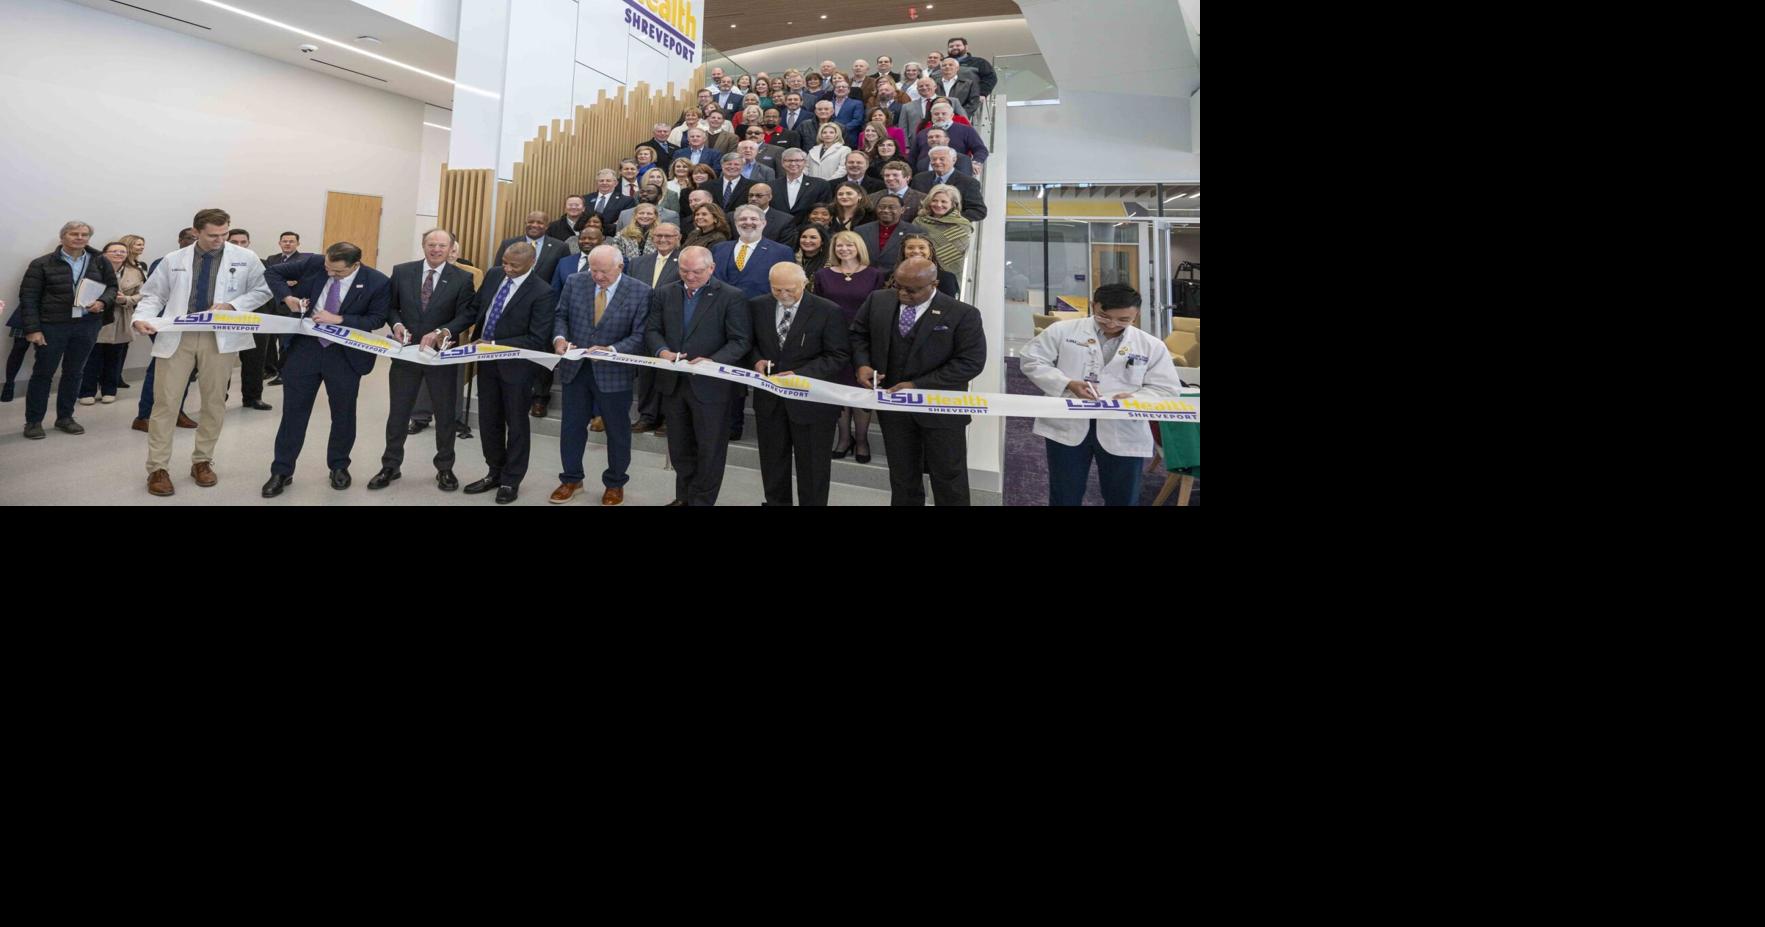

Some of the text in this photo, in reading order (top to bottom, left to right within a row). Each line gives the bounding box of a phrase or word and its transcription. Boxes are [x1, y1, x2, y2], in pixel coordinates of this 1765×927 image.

[639, 0, 697, 41] ealth
[625, 8, 695, 63] SHREVEPORT
[174, 313, 212, 322] LSU
[313, 323, 350, 337] LSU
[344, 339, 388, 354] SHREVEPORT
[477, 352, 520, 360] SHREVEPORT
[760, 381, 808, 398] SHREVEPORT
[877, 391, 988, 406] LSU Health
[1066, 399, 1196, 411] LSU Health
[1128, 412, 1197, 420] SHREVEPORT
